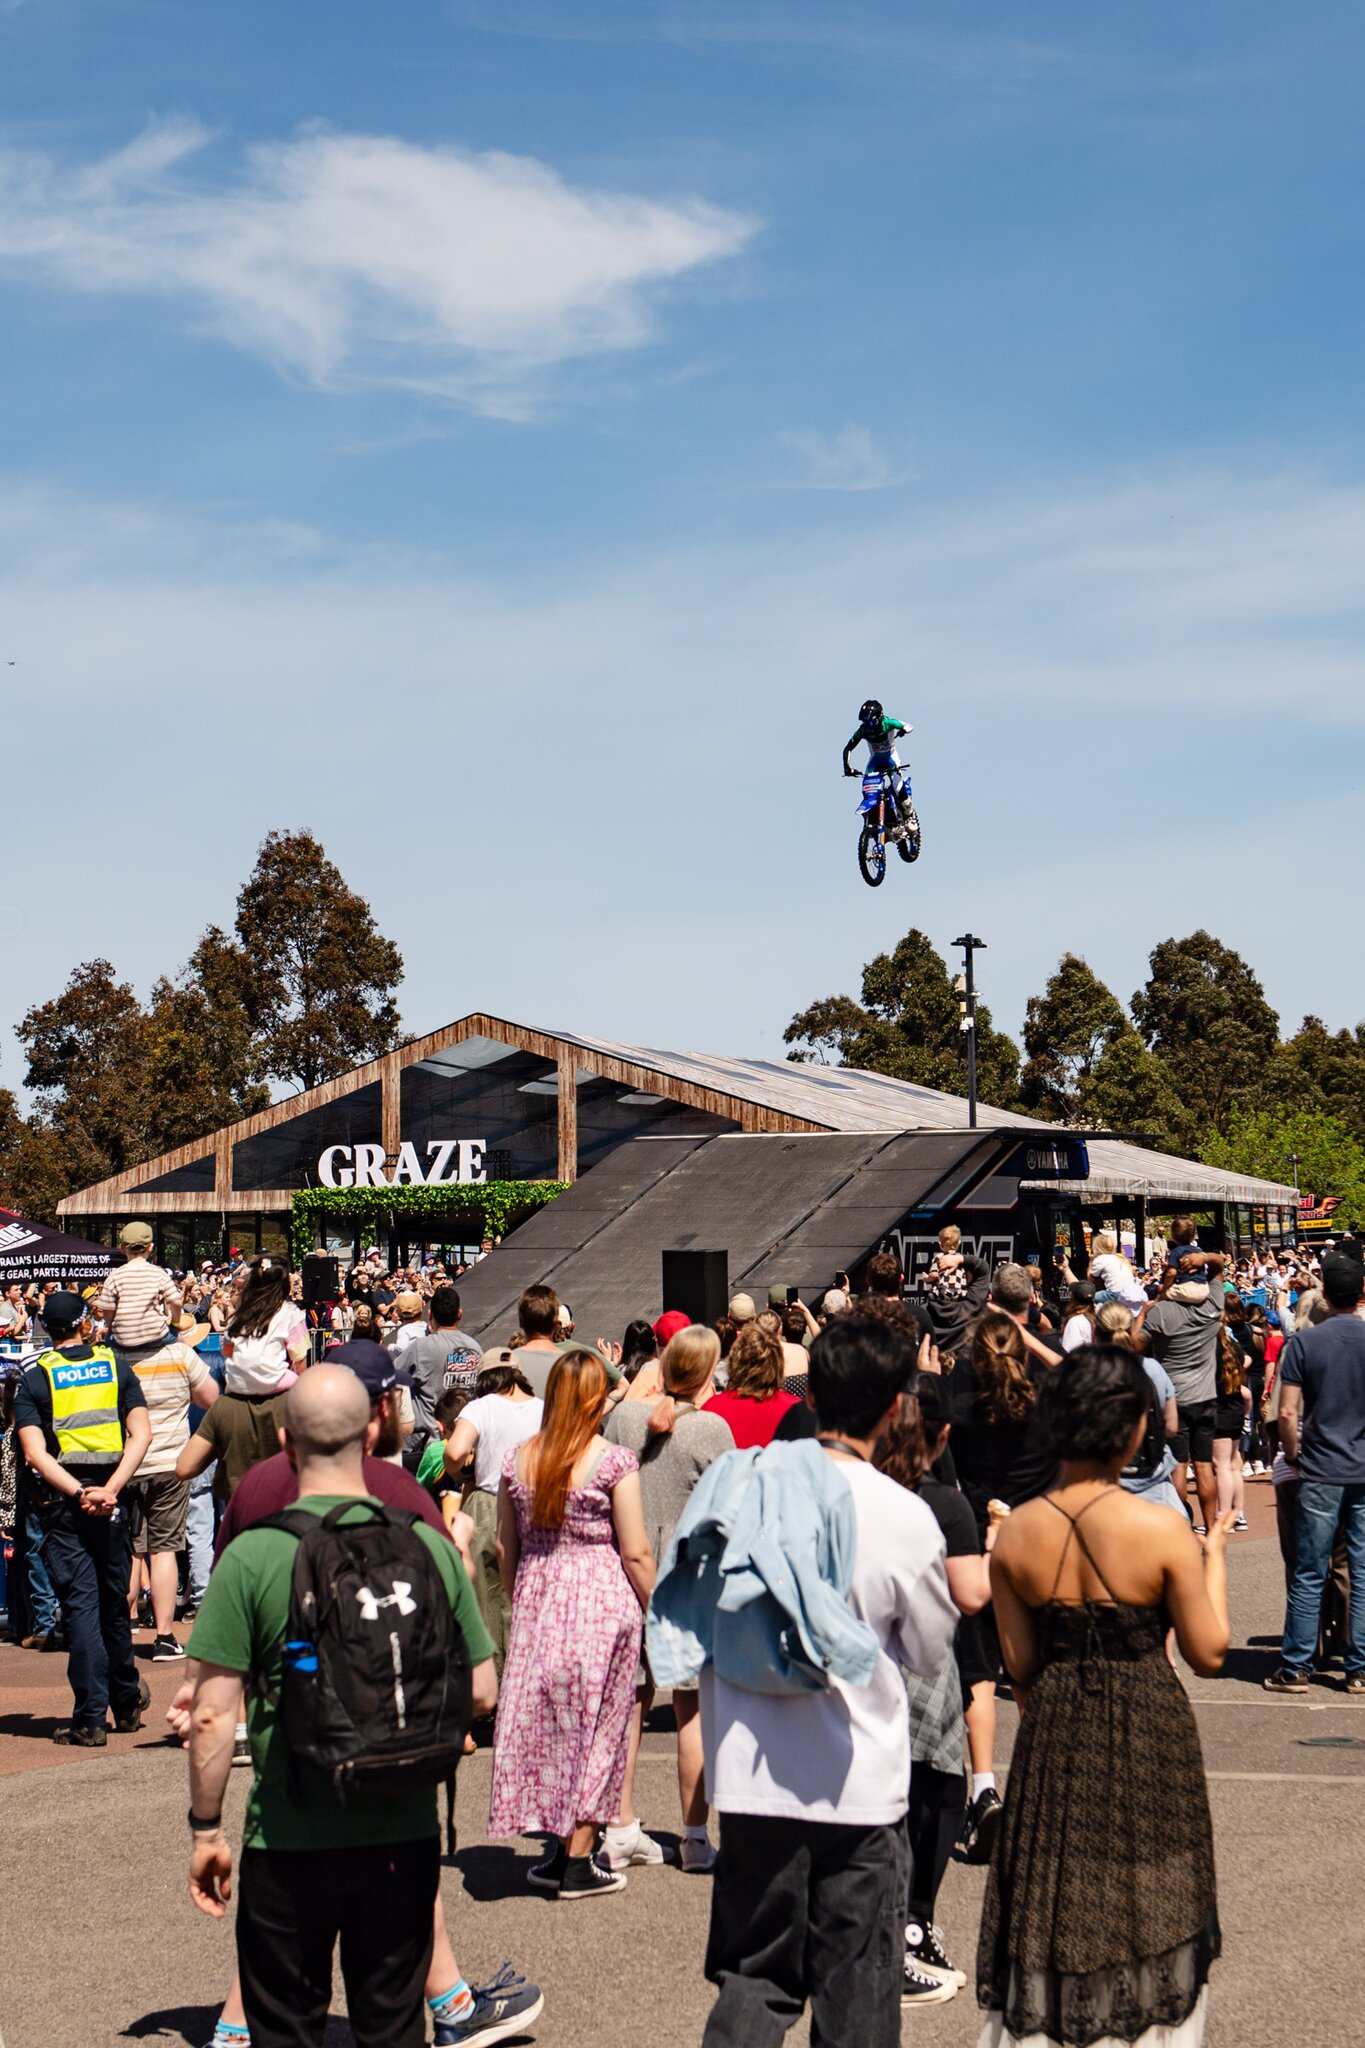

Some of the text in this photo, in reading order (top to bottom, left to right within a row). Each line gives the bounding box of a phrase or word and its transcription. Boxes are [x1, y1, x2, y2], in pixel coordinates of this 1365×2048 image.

[318, 1139, 487, 1188] GRAZE
[1036, 1151, 1069, 1169] YAMAHA
[0, 1255, 111, 1266] RALIA'S LARGEST RANGE OF
[7, 1269, 32, 1280] GEAR,
[33, 1267, 59, 1278] PARTS
[61, 1268, 67, 1277] &
[57, 1366, 109, 1383] POLICE
